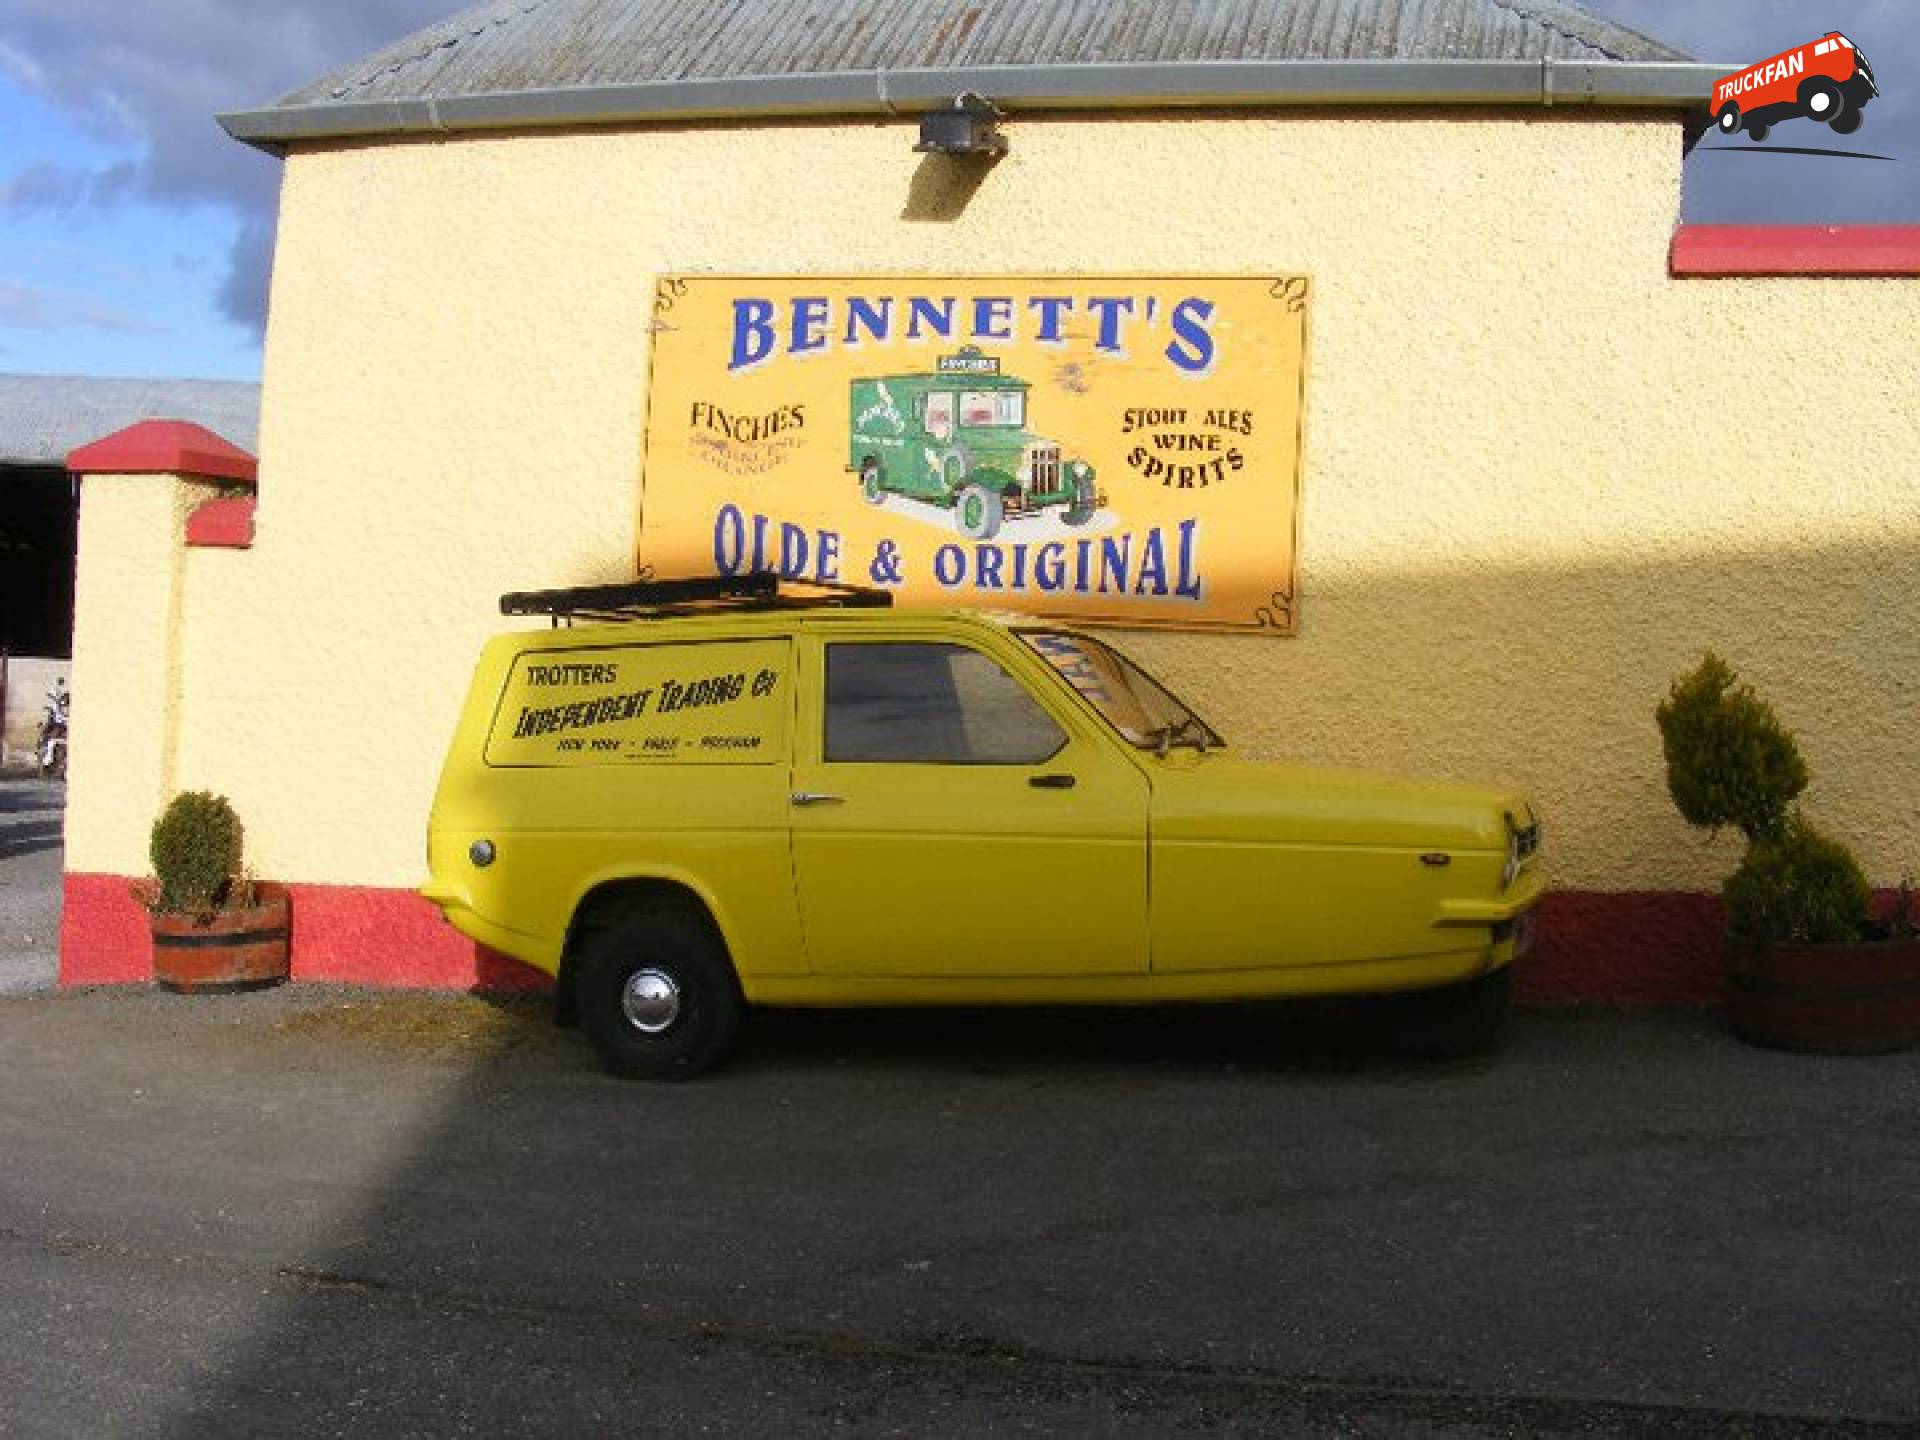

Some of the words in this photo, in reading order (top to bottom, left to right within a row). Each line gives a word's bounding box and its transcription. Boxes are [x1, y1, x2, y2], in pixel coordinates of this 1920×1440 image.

[727, 296, 1216, 373] BENNETT'S
[690, 402, 806, 442] FINCHES
[1122, 408, 1187, 433] STOUT
[1203, 408, 1253, 435] ALES
[1152, 434, 1222, 451] WINE
[1127, 447, 1244, 488] SPIRITS
[714, 503, 839, 584] OLDE
[869, 538, 903, 584] &
[934, 519, 1201, 599] ORIGINAL
[527, 664, 619, 686] TROTTERS
